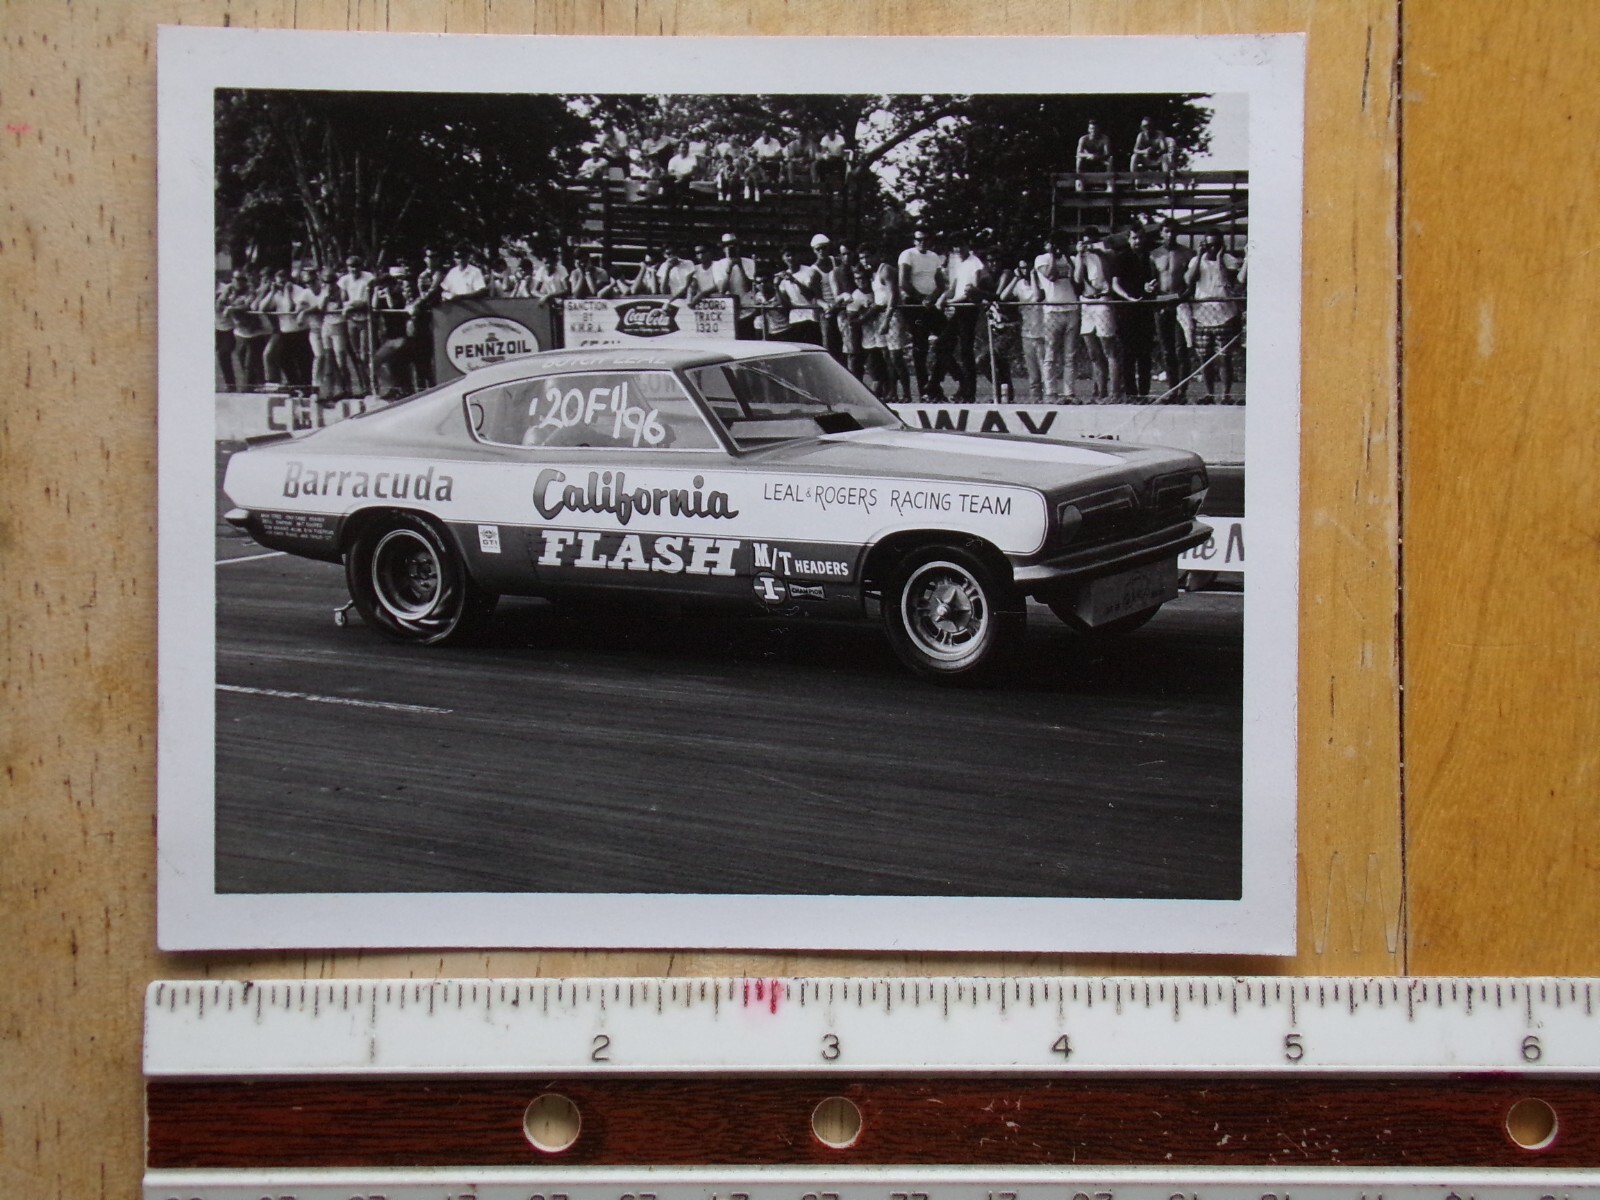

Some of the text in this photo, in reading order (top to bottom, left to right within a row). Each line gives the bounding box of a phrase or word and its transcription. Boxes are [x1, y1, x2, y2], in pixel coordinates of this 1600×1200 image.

[694, 311, 722, 322] TRACK
[696, 322, 719, 333] 1320
[454, 340, 532, 359] PENNZOIL
[282, 461, 454, 501] Barracuda
[532, 468, 740, 526] California
[763, 483, 804, 502] LEAL
[814, 485, 877, 514] ROGERS
[890, 490, 951, 516] RACING
[958, 494, 1012, 515] TEAM
[537, 529, 741, 576] FLASH
[752, 542, 849, 576] M/T HEADERS
[791, 587, 823, 595] CHAMPION
[590, 1034, 611, 1062] 2
[821, 1033, 841, 1061] 3
[1050, 1034, 1073, 1059] 4
[1284, 1033, 1304, 1062] 5
[1521, 1034, 1543, 1063] 6
